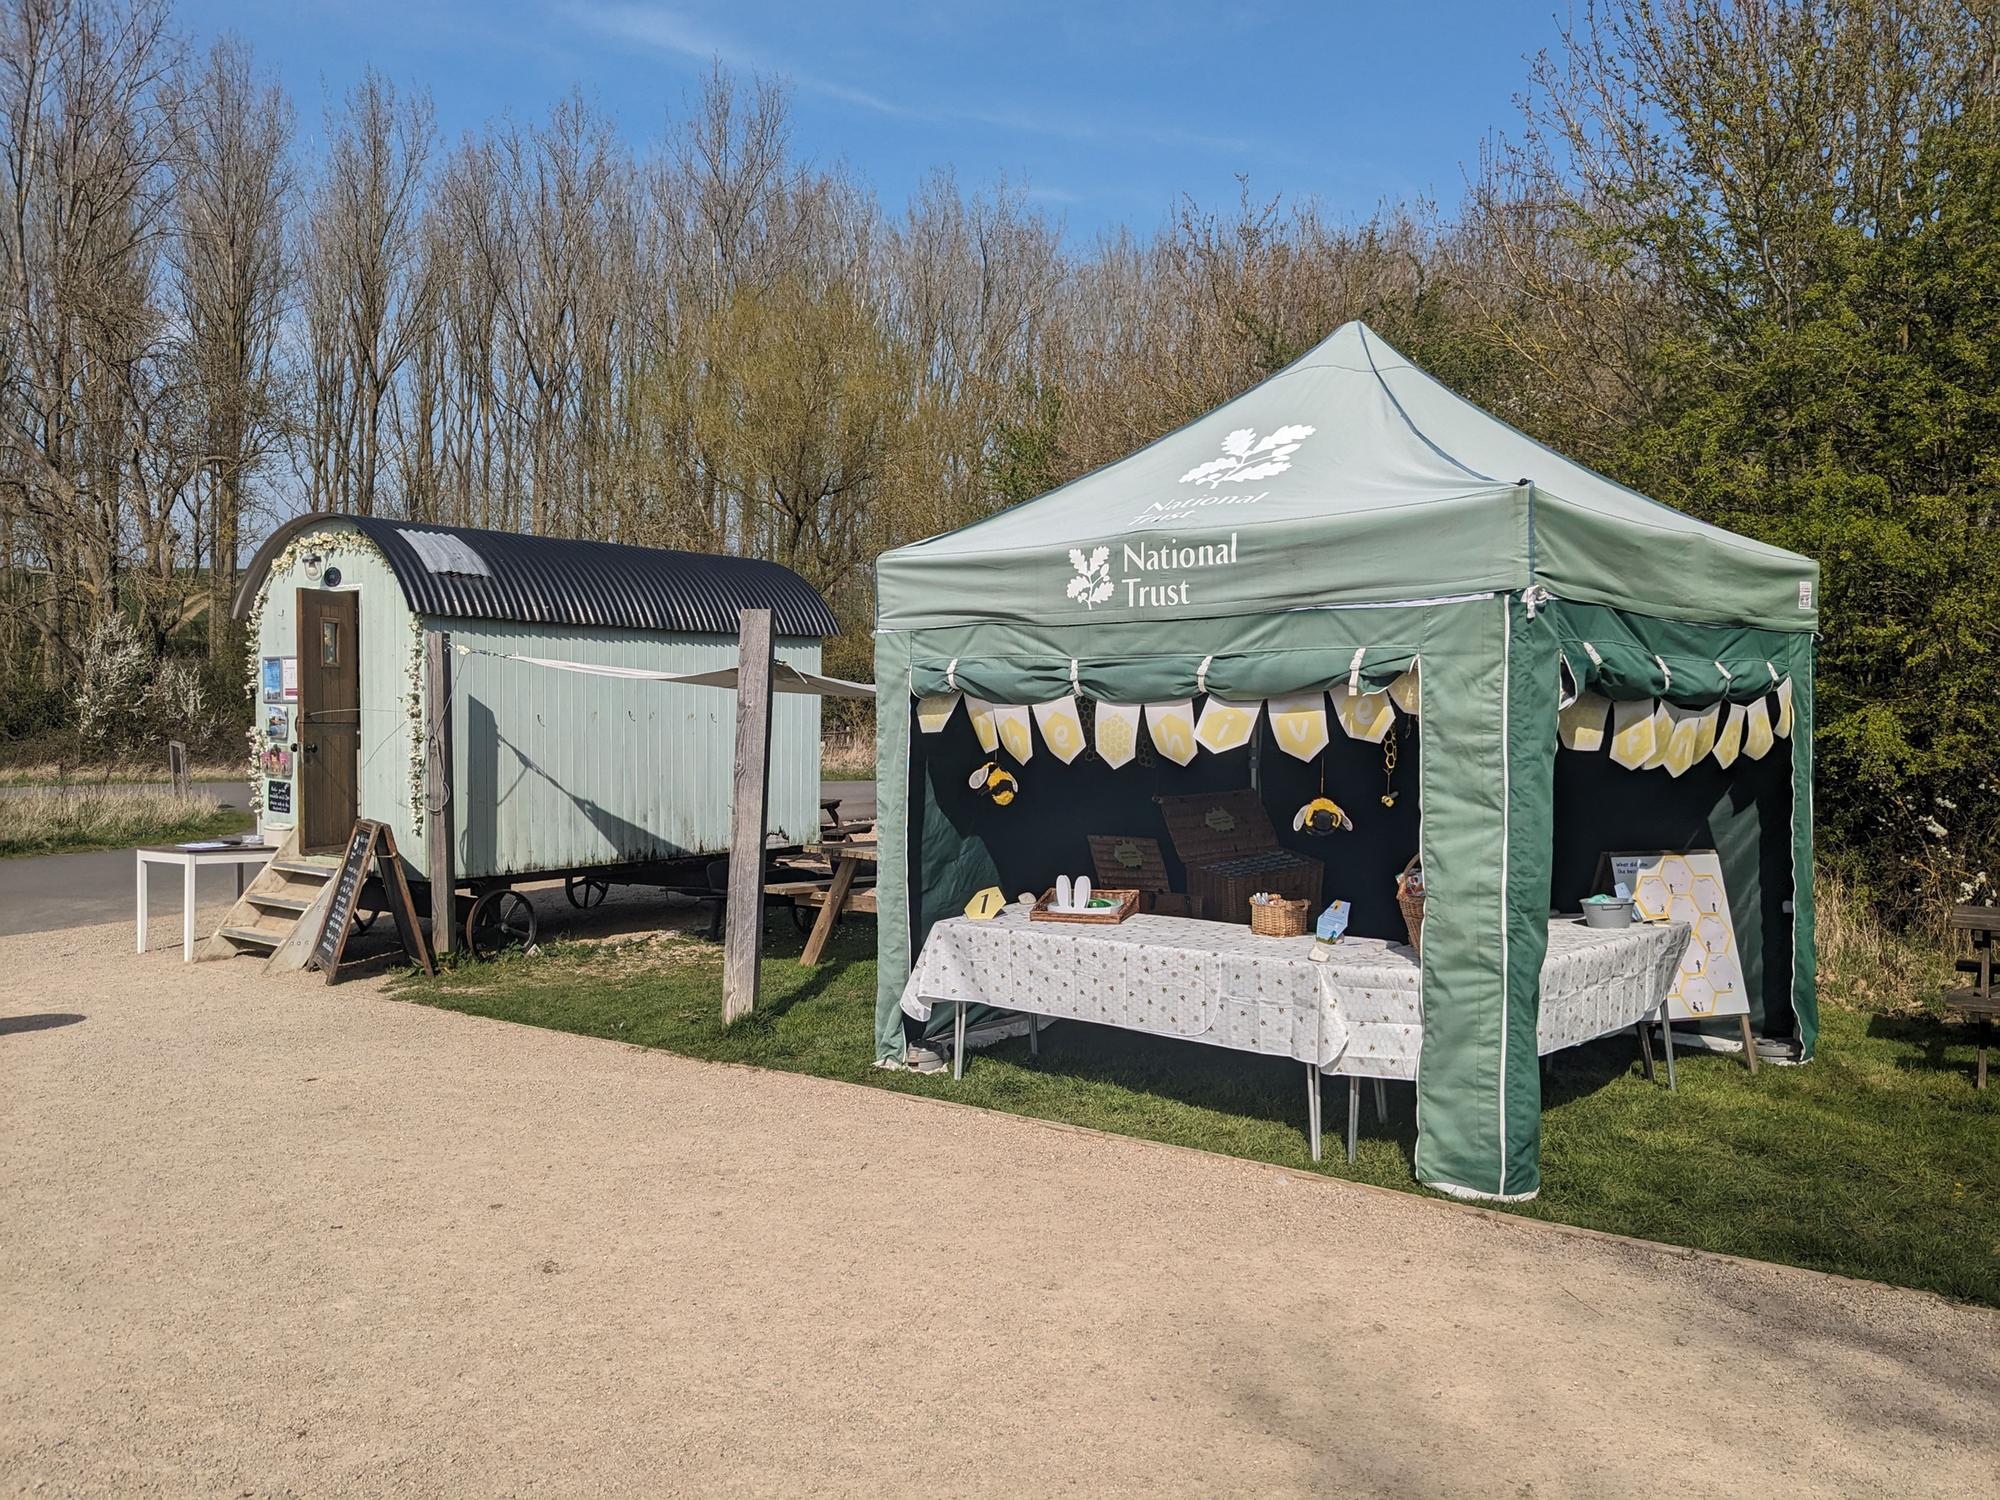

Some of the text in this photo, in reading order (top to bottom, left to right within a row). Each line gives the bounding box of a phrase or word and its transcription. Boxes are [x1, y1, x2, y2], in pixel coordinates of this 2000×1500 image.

[1143, 491, 1270, 514] National
[1127, 510, 1196, 526] Trust
[1123, 532, 1238, 573] National
[1121, 578, 1191, 608] Trust
[980, 893, 990, 914] 1
